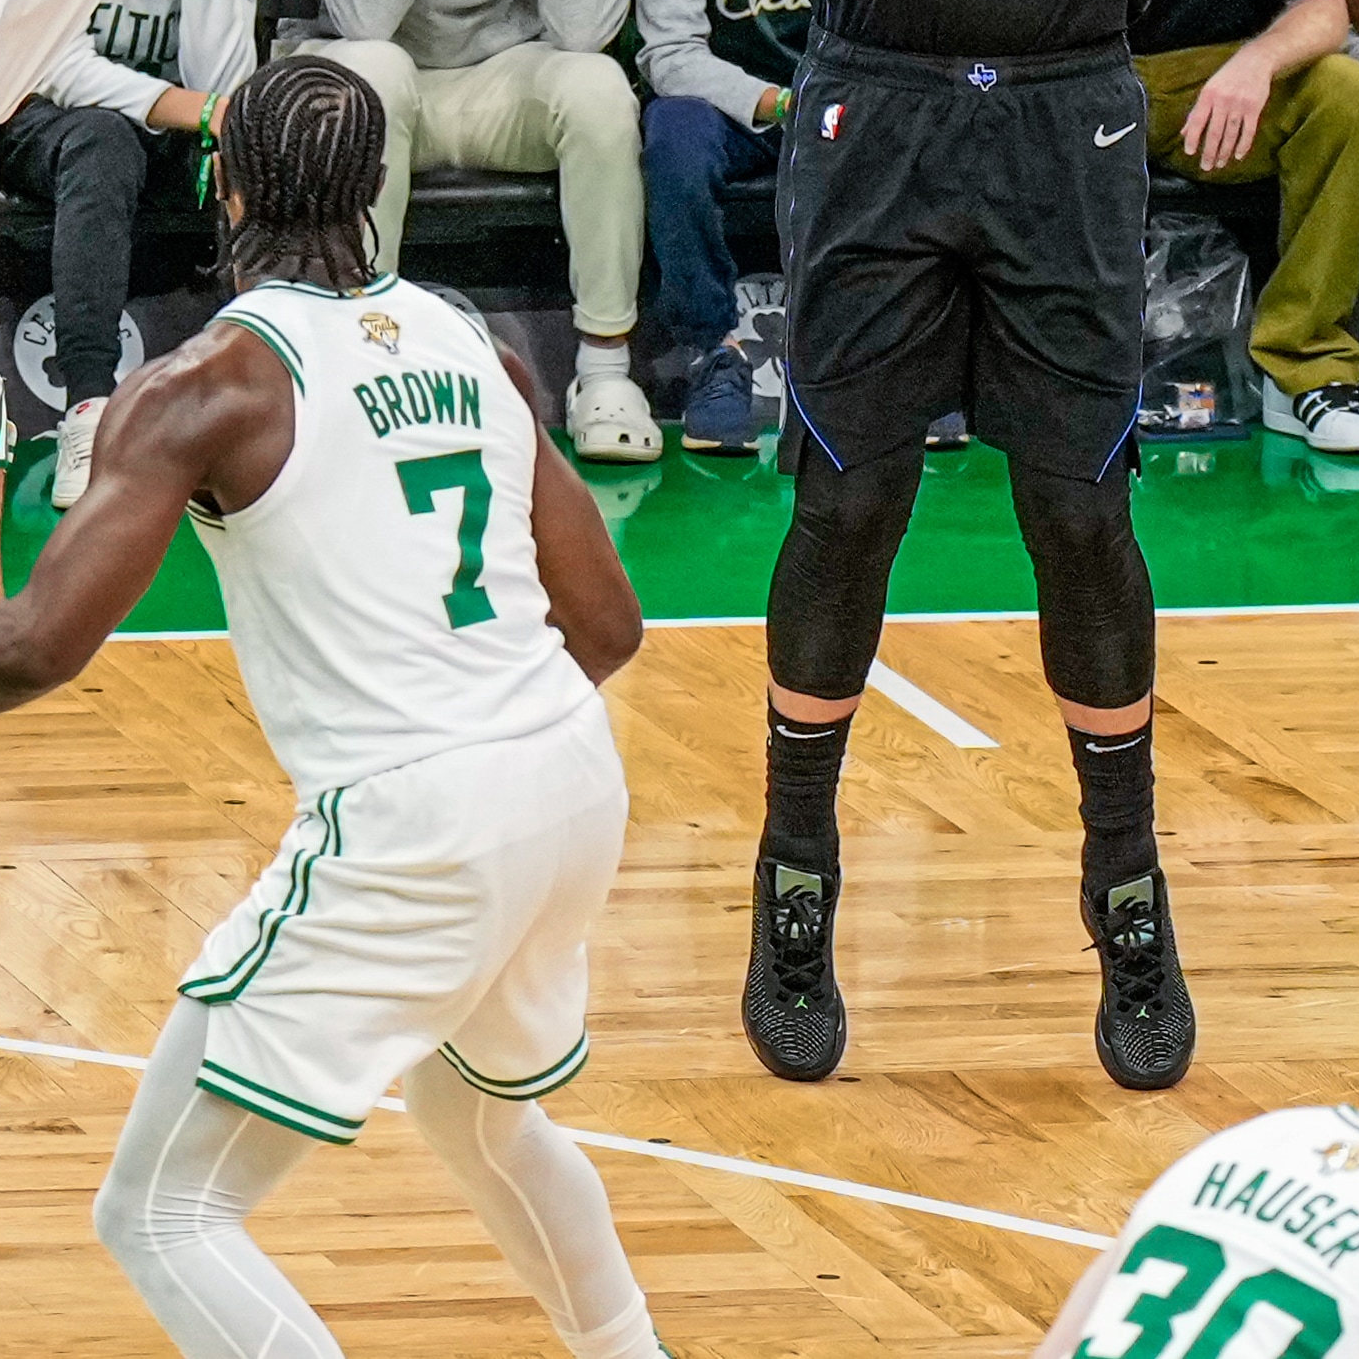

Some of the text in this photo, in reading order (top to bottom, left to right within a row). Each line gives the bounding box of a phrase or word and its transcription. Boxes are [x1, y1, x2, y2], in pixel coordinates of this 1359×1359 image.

[86, 2, 182, 62] ELTIC
[353, 369, 482, 438] BROWN
[395, 449, 498, 629] 7
[1072, 1224, 1344, 1359] 30
